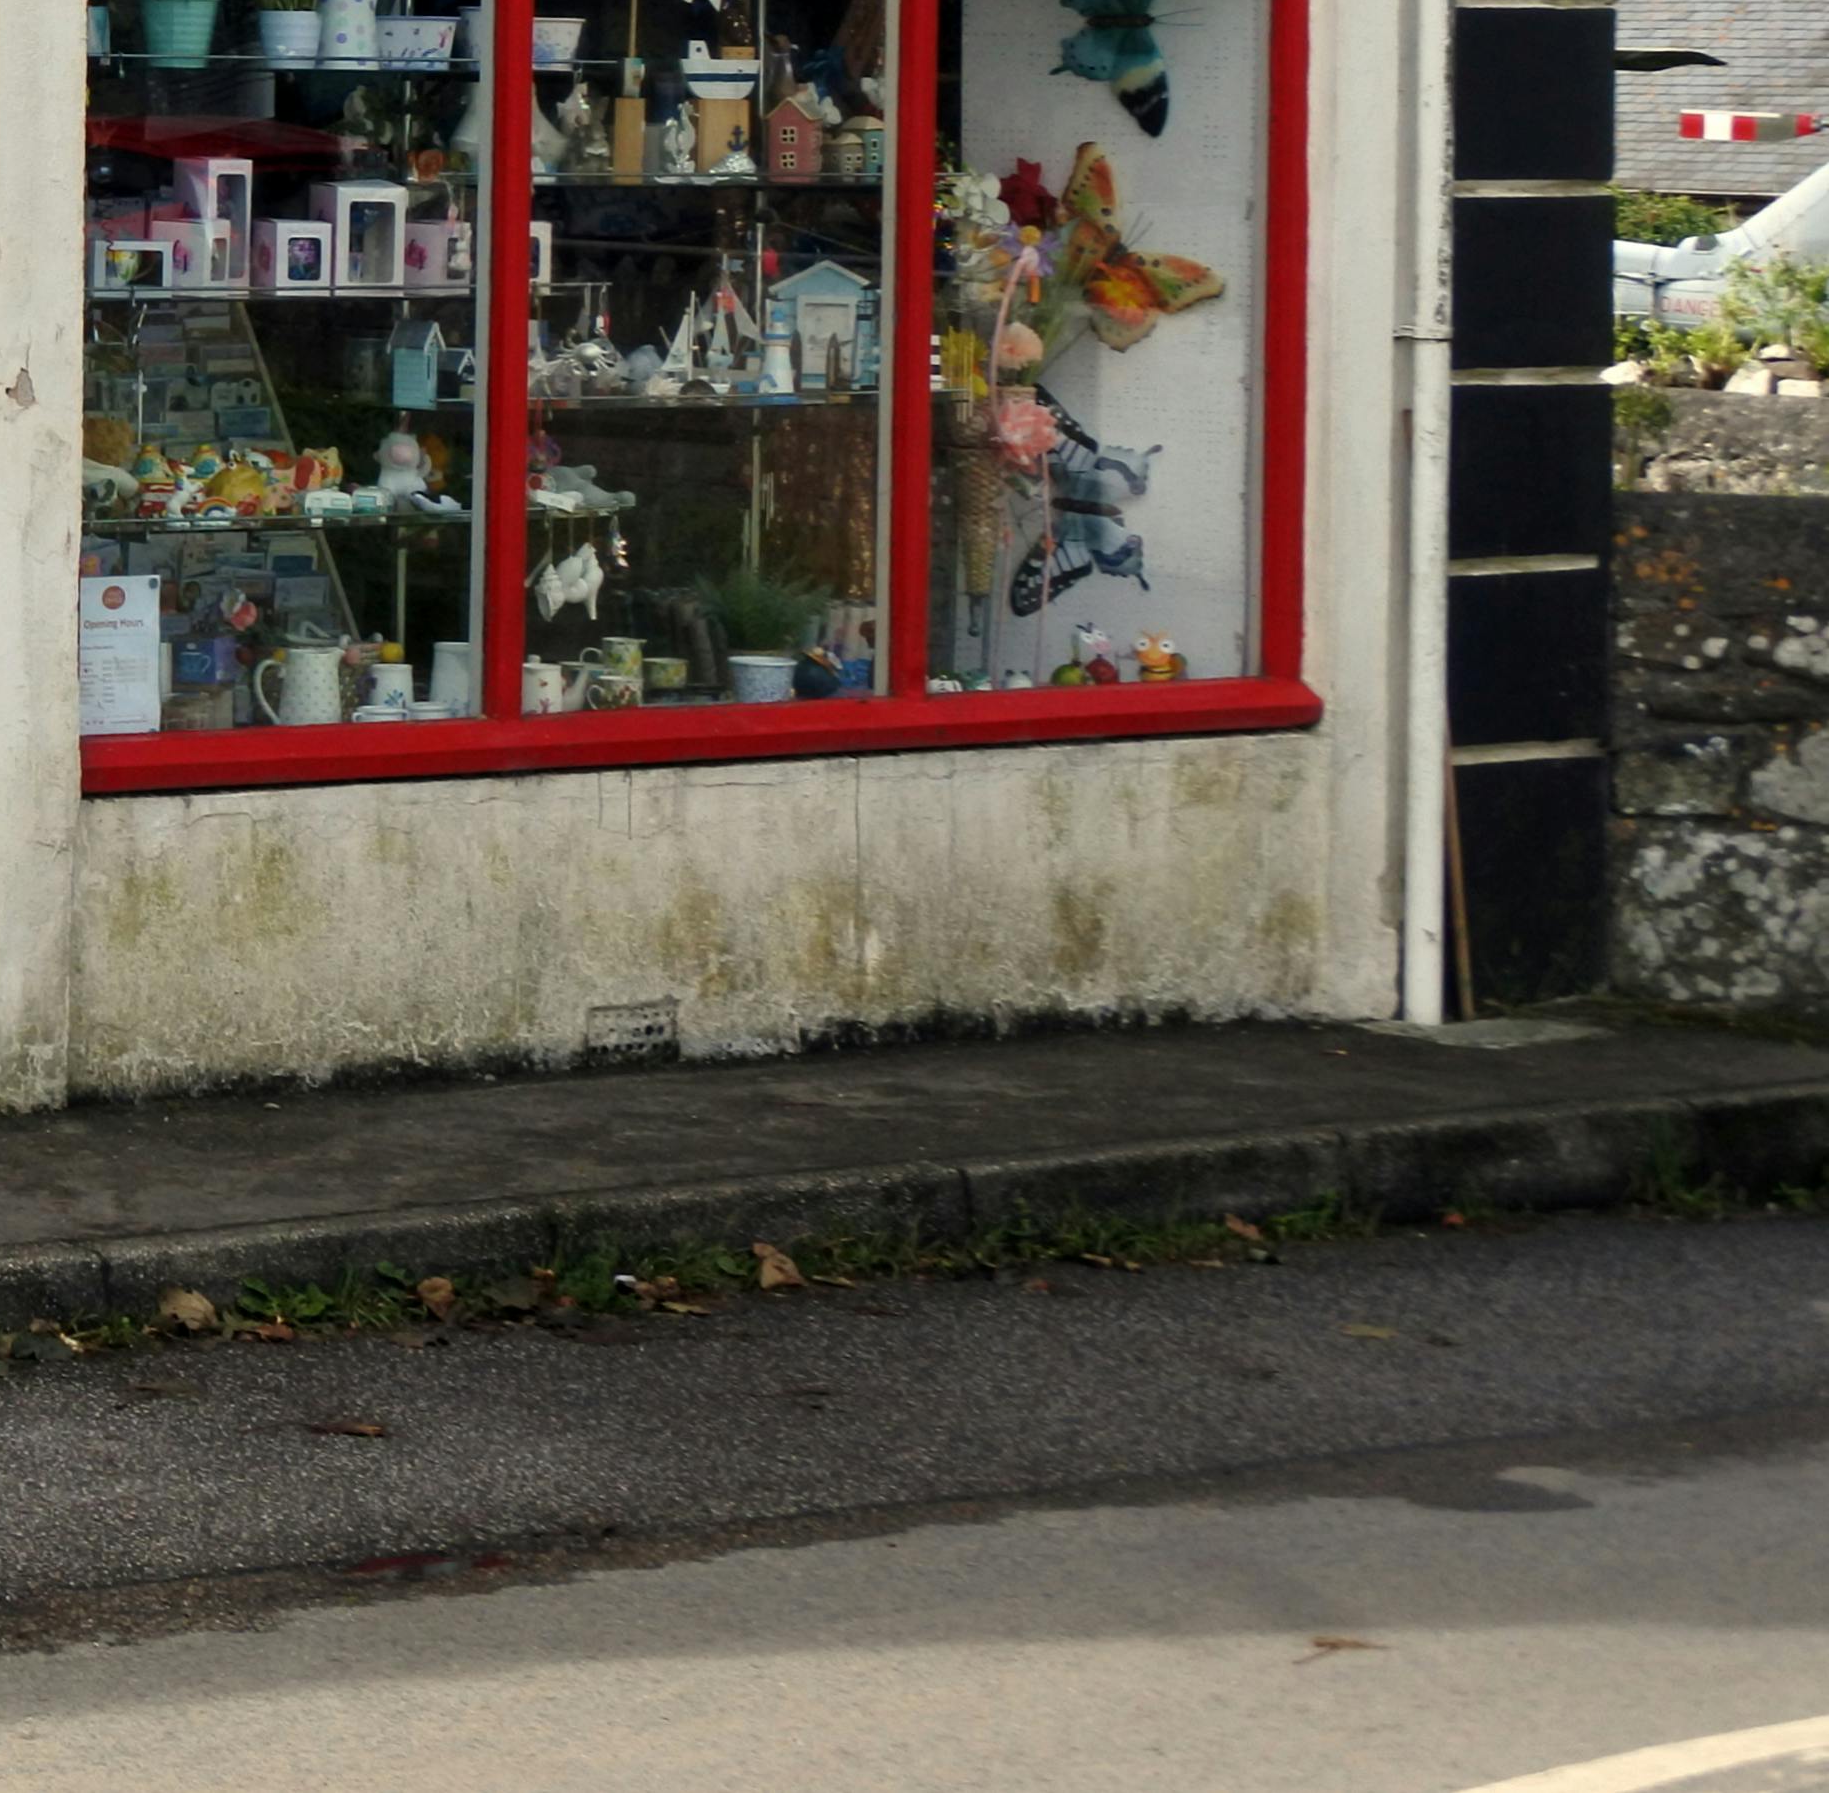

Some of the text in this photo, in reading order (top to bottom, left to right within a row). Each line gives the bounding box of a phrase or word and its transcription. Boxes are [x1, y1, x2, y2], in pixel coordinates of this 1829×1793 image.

[1660, 295, 1721, 318] DANGE
[83, 617, 144, 630] Opening Hours
